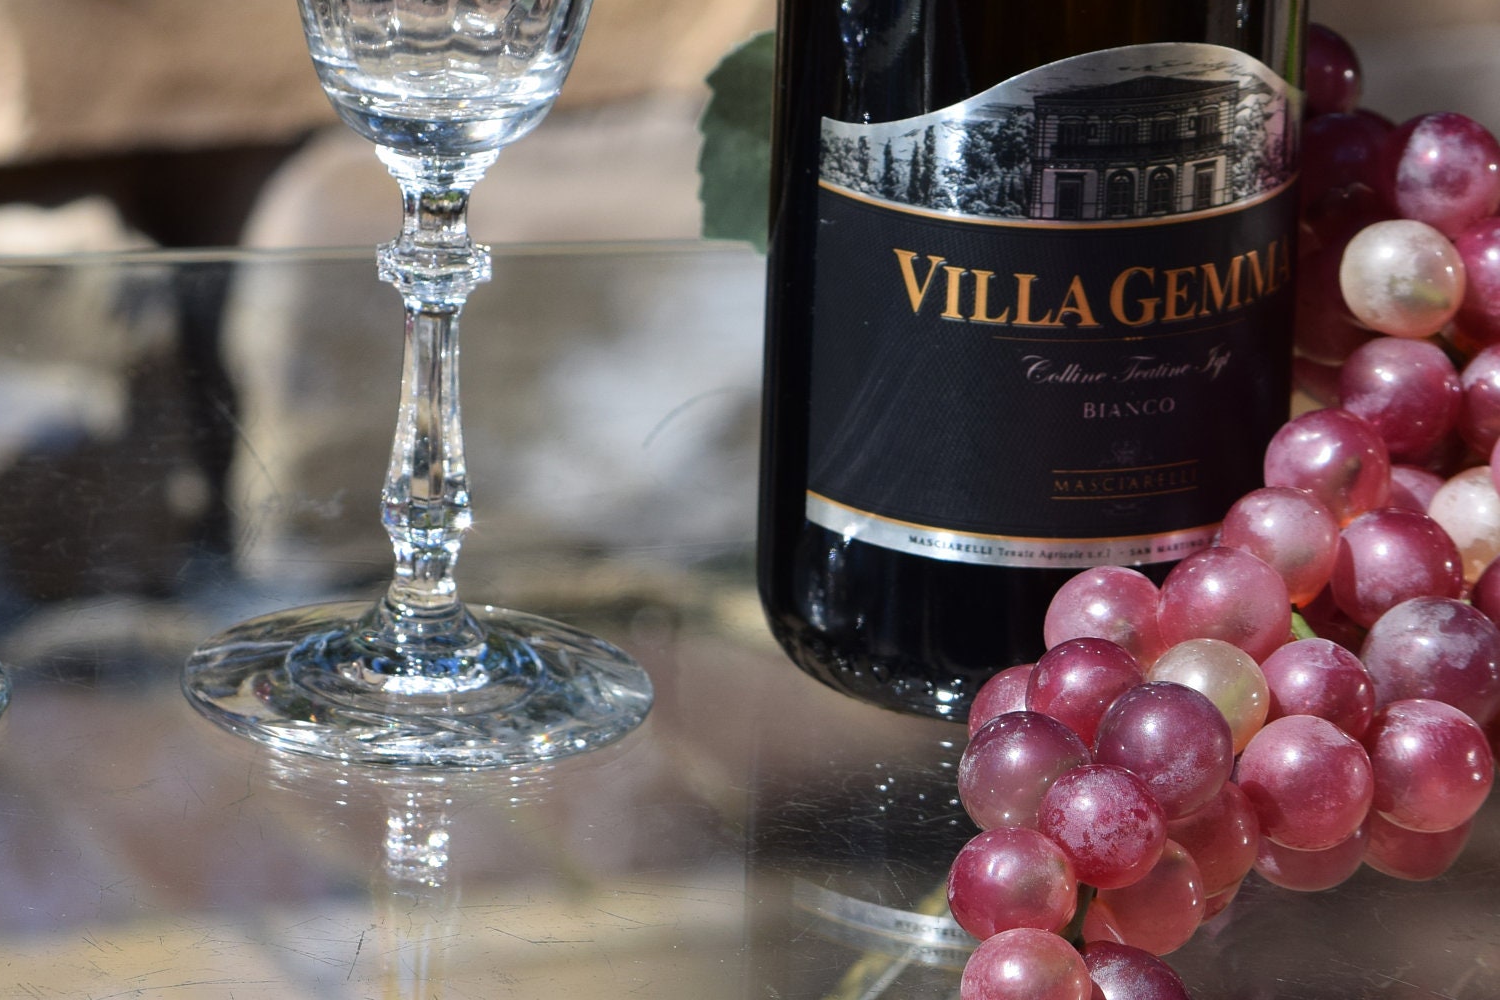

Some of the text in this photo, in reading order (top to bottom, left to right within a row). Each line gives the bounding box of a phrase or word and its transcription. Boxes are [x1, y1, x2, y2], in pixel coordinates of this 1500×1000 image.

[892, 234, 1291, 328] VILLA GEMMA
[1021, 354, 1108, 384] Colline
[1083, 396, 1176, 419] BIANCO
[1053, 467, 1198, 493] MASCIARELLI
[908, 535, 993, 555] MASCIARELLI
